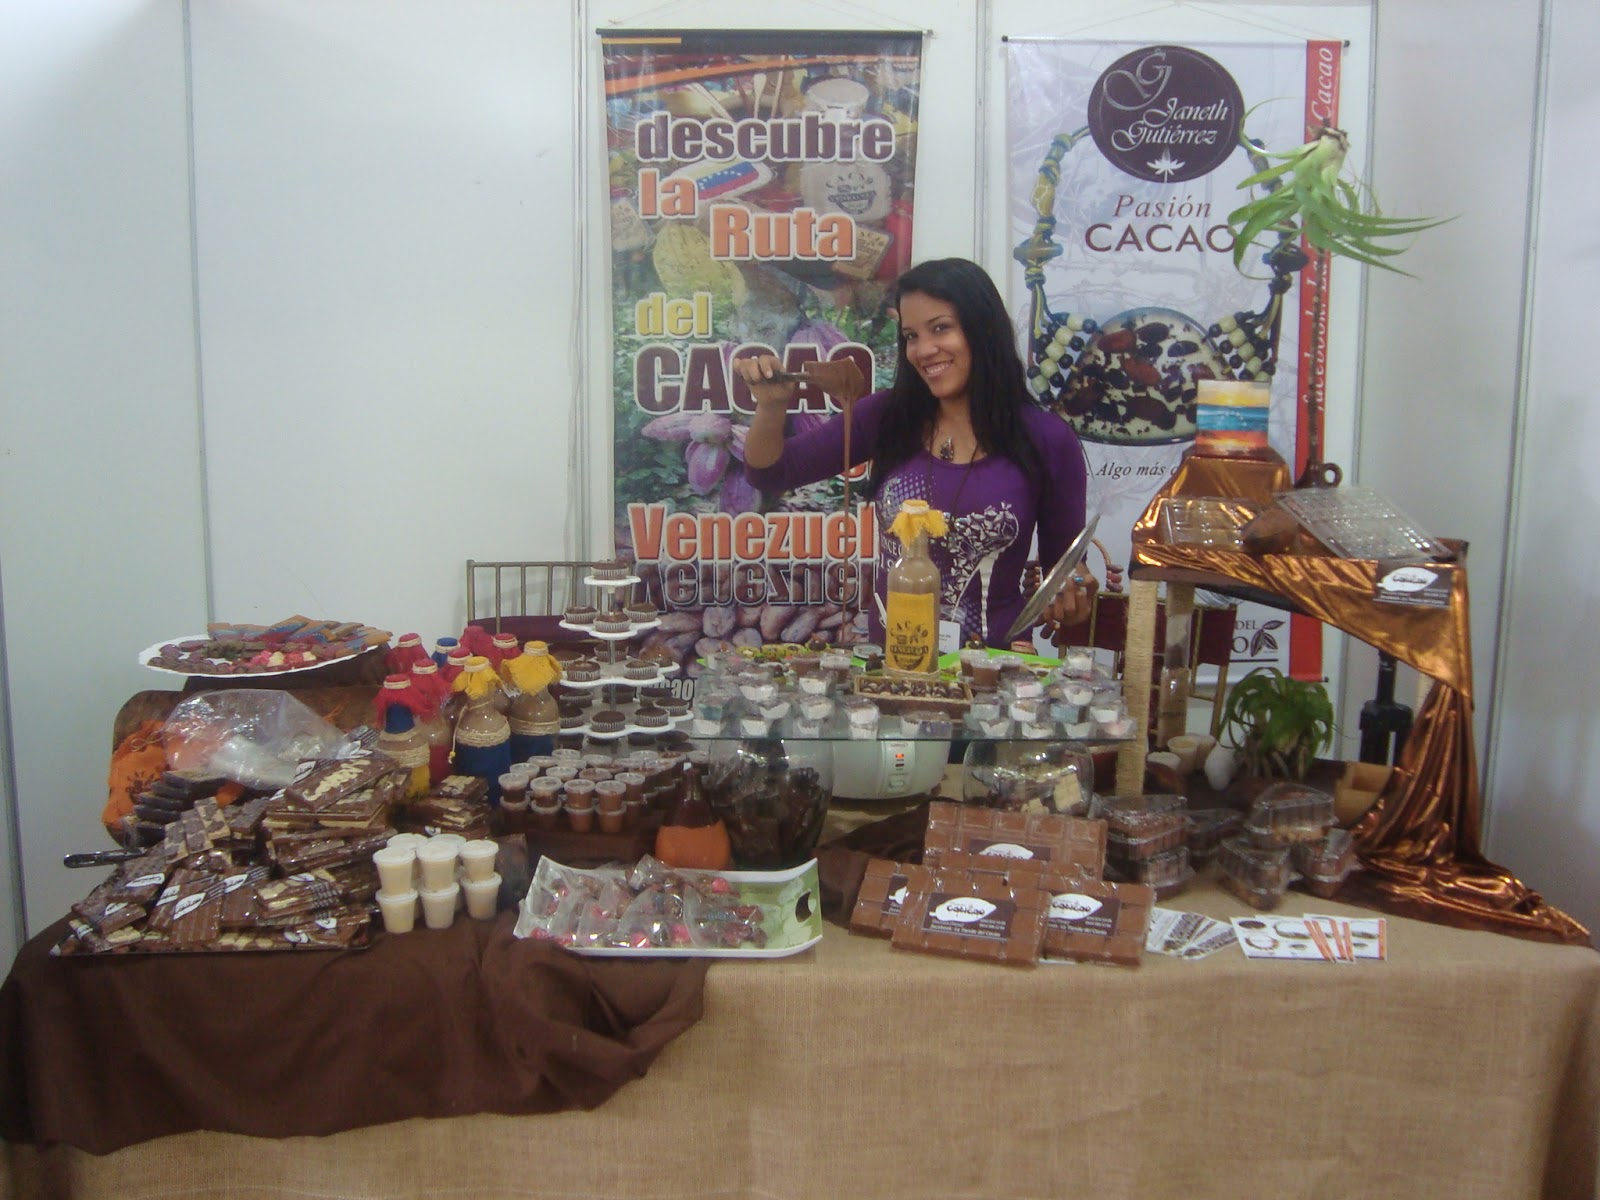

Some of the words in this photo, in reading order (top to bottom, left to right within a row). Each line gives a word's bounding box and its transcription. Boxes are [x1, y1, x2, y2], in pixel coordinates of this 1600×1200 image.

[1311, 47, 1333, 121] Cacao
[1143, 97, 1228, 128] Janeth
[636, 111, 895, 162] descubre
[1111, 120, 1217, 151] Gutiérrez
[639, 168, 699, 219] la
[1113, 194, 1211, 218] Pasión
[710, 204, 857, 261] Ruta
[1085, 223, 1237, 253] CACAO
[635, 292, 712, 339] del
[1097, 462, 1132, 479] Algo
[1136, 462, 1166, 476] más
[1236, 620, 1257, 630] DEL
